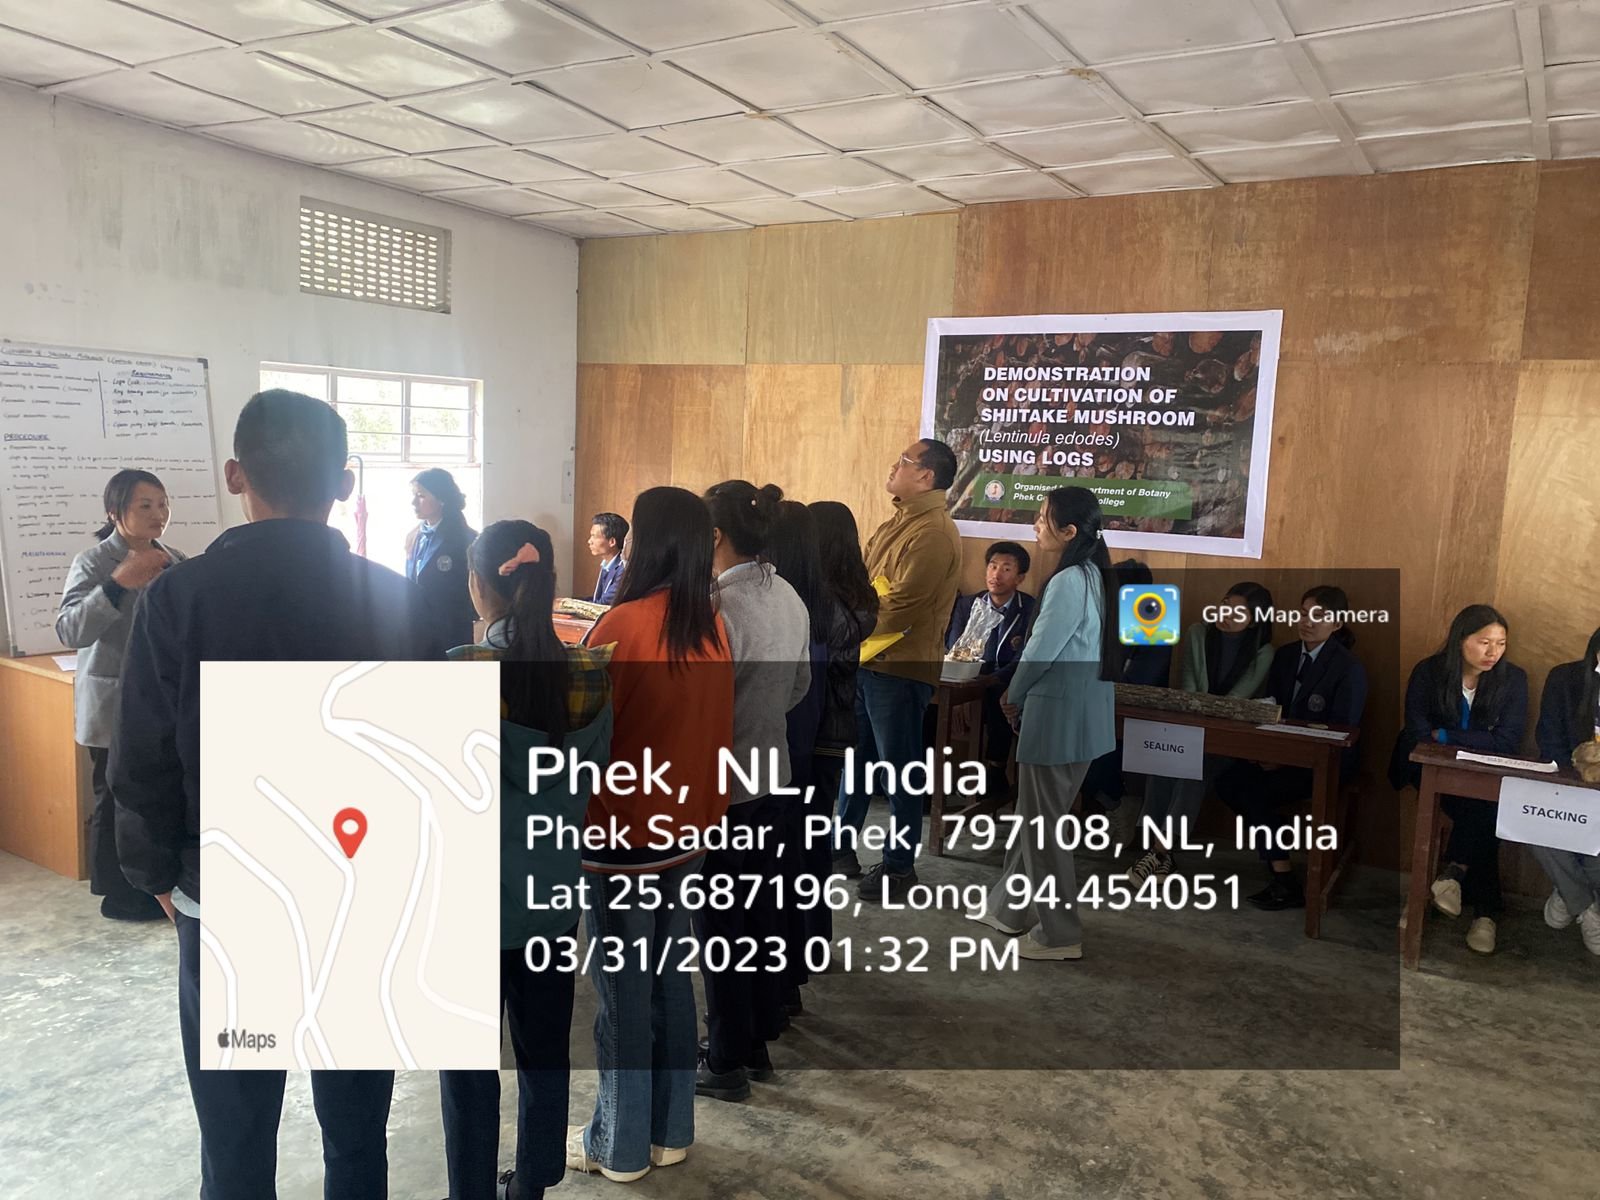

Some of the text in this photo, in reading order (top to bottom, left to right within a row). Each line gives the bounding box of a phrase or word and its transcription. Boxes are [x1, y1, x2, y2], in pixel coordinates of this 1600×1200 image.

[983, 366, 1151, 382] DEMONSTRATION
[982, 387, 1178, 404] ON CULTIVATION OF
[981, 408, 1195, 426] SHIITAKE MUSHROOM
[978, 428, 1121, 449] (Lentinula edodes)
[978, 448, 1094, 467] USING LOGS
[1013, 492, 1035, 501] Phek
[1098, 497, 1126, 508] ollege
[1126, 488, 1137, 496] of
[1138, 488, 1171, 499] Botany
[1143, 740, 1185, 754] SEALING
[1522, 804, 1588, 824] STACKING
